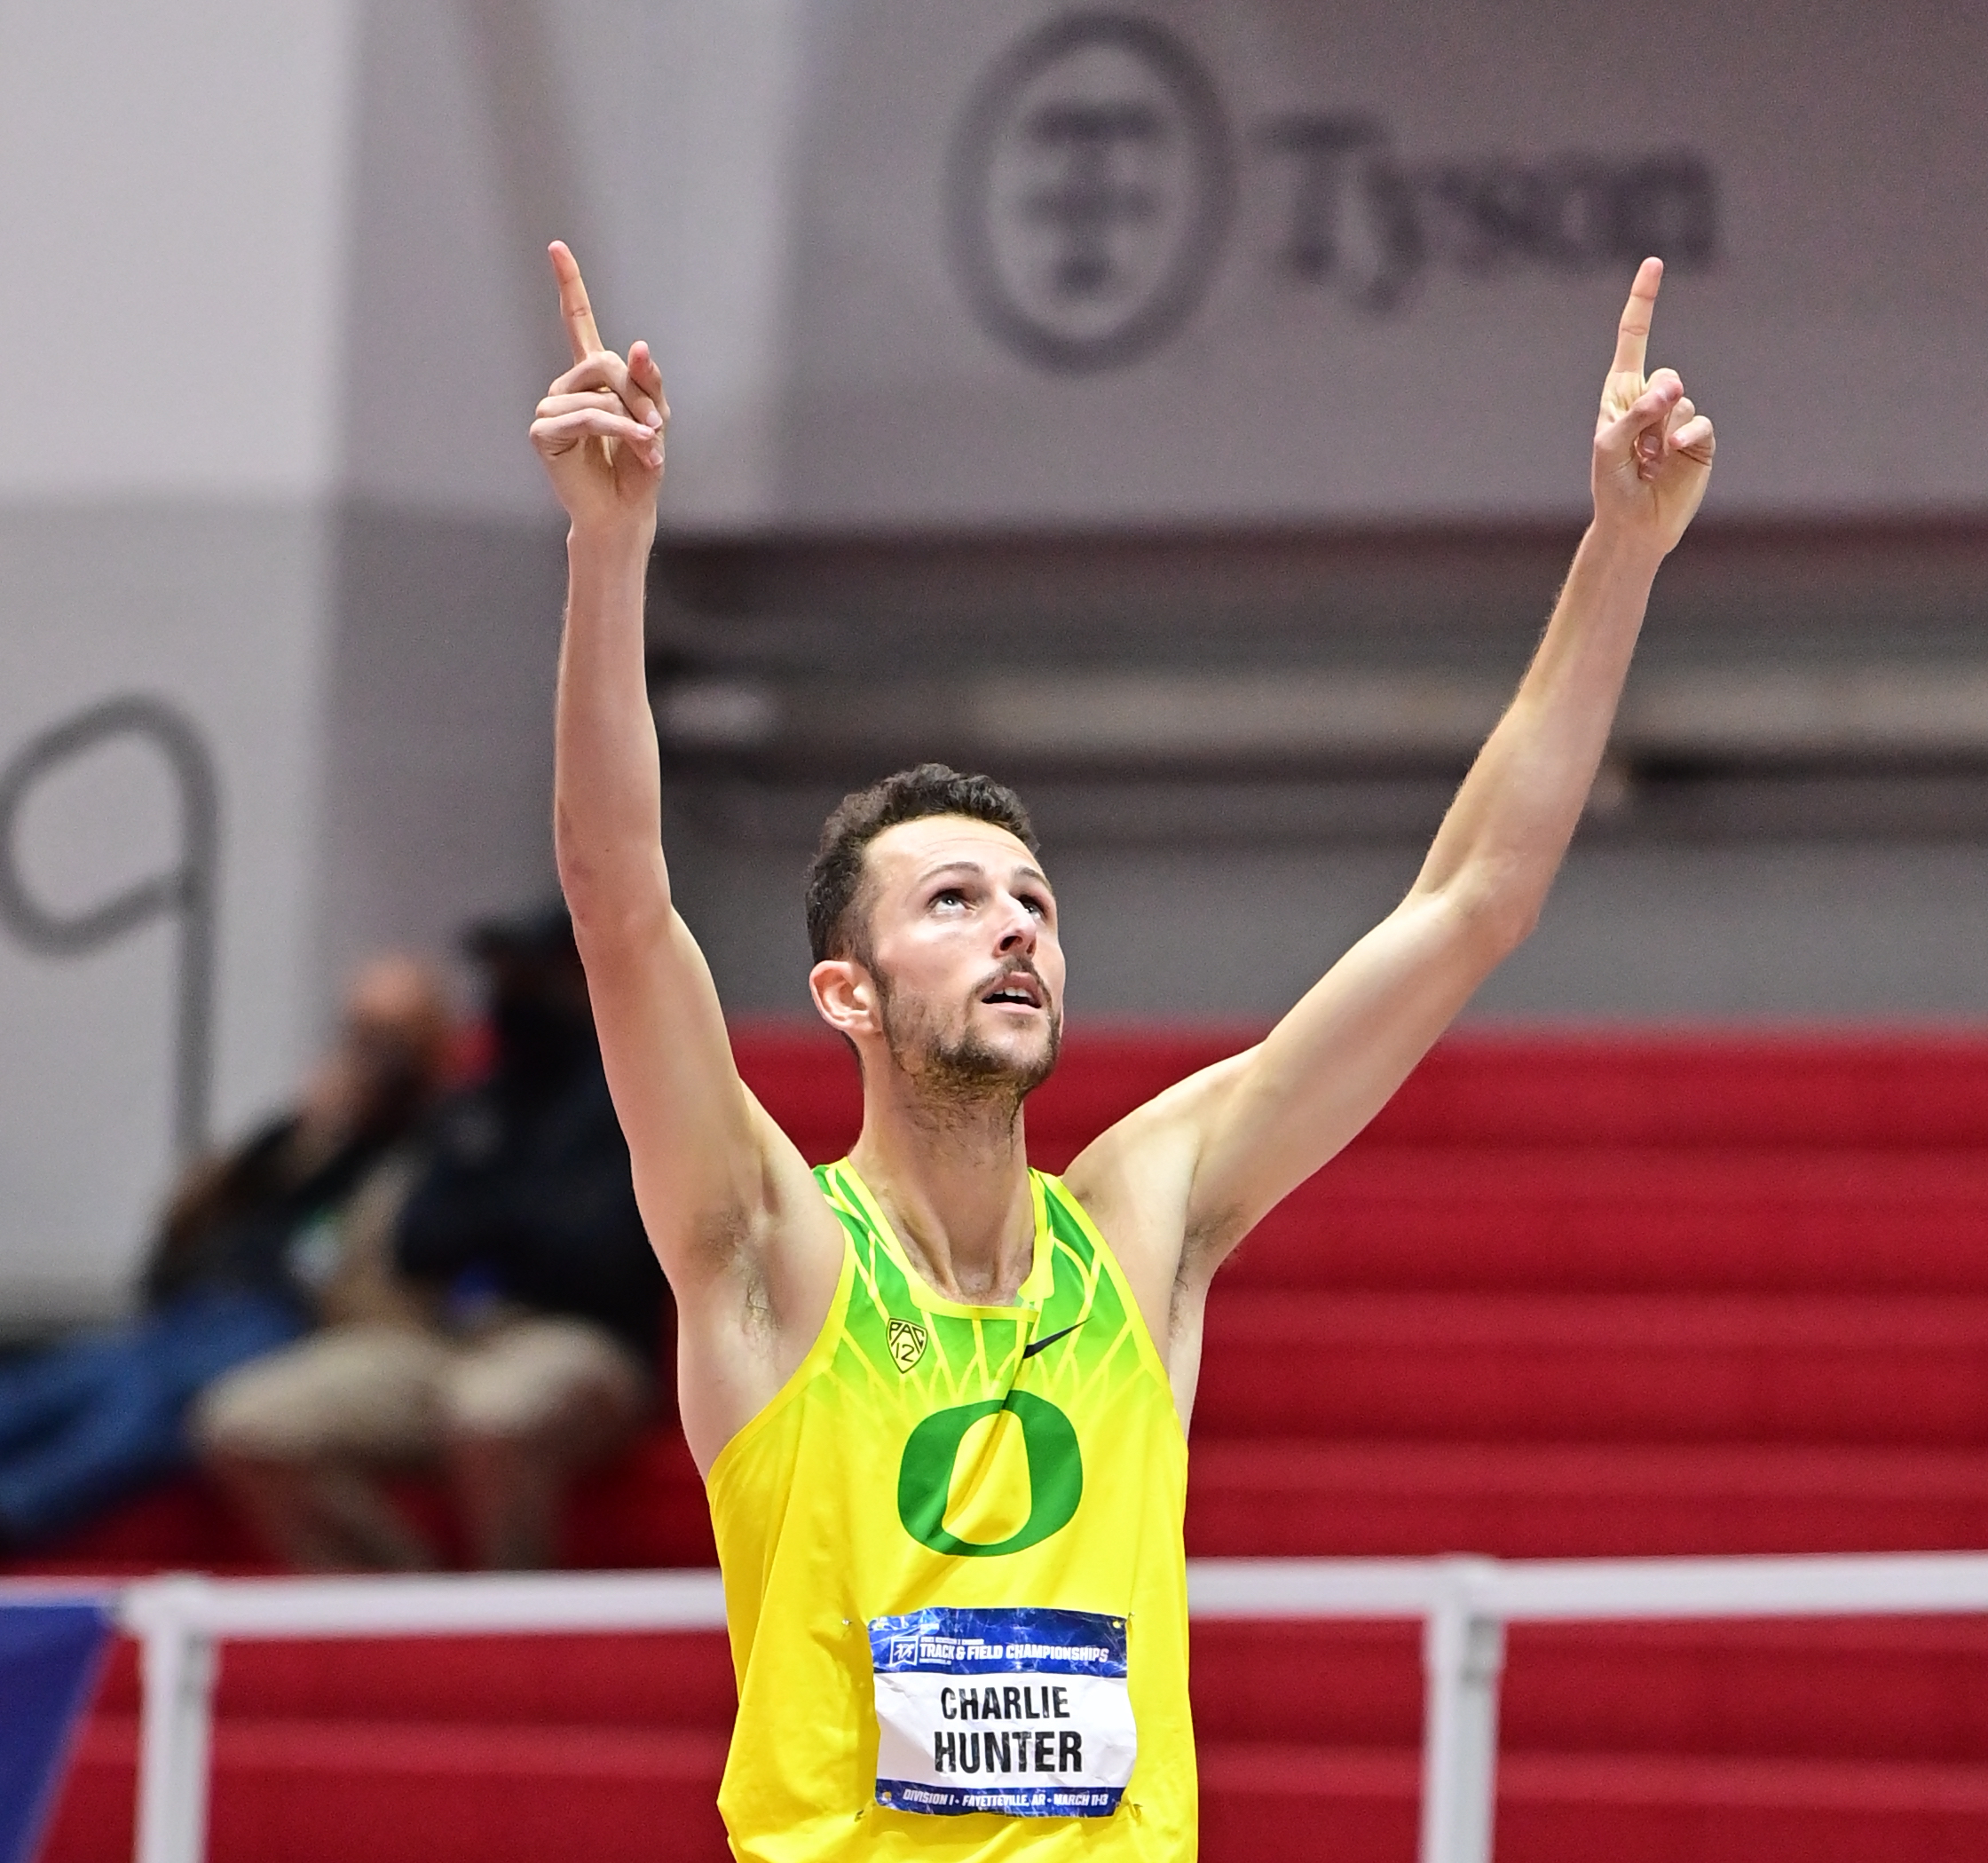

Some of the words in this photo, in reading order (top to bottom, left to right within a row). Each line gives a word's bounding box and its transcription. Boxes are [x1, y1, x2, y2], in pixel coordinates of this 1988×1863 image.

[1255, 107, 1716, 318] Tyson
[889, 1322, 924, 1354] PAC
[895, 1342, 914, 1362] 12
[897, 1390, 1083, 1557] O
[919, 1644, 955, 1660] TRACK
[956, 1646, 966, 1660] &
[967, 1646, 1003, 1660] FIELD
[1006, 1644, 1109, 1662] CHAMPIONSHIPS
[941, 1686, 1070, 1720] CHARLIE
[935, 1731, 1082, 1773] HUNTER
[903, 1788, 948, 1805] DIVISION
[1031, 1794, 1045, 1805] AR
[1053, 1794, 1090, 1806] MARCH
